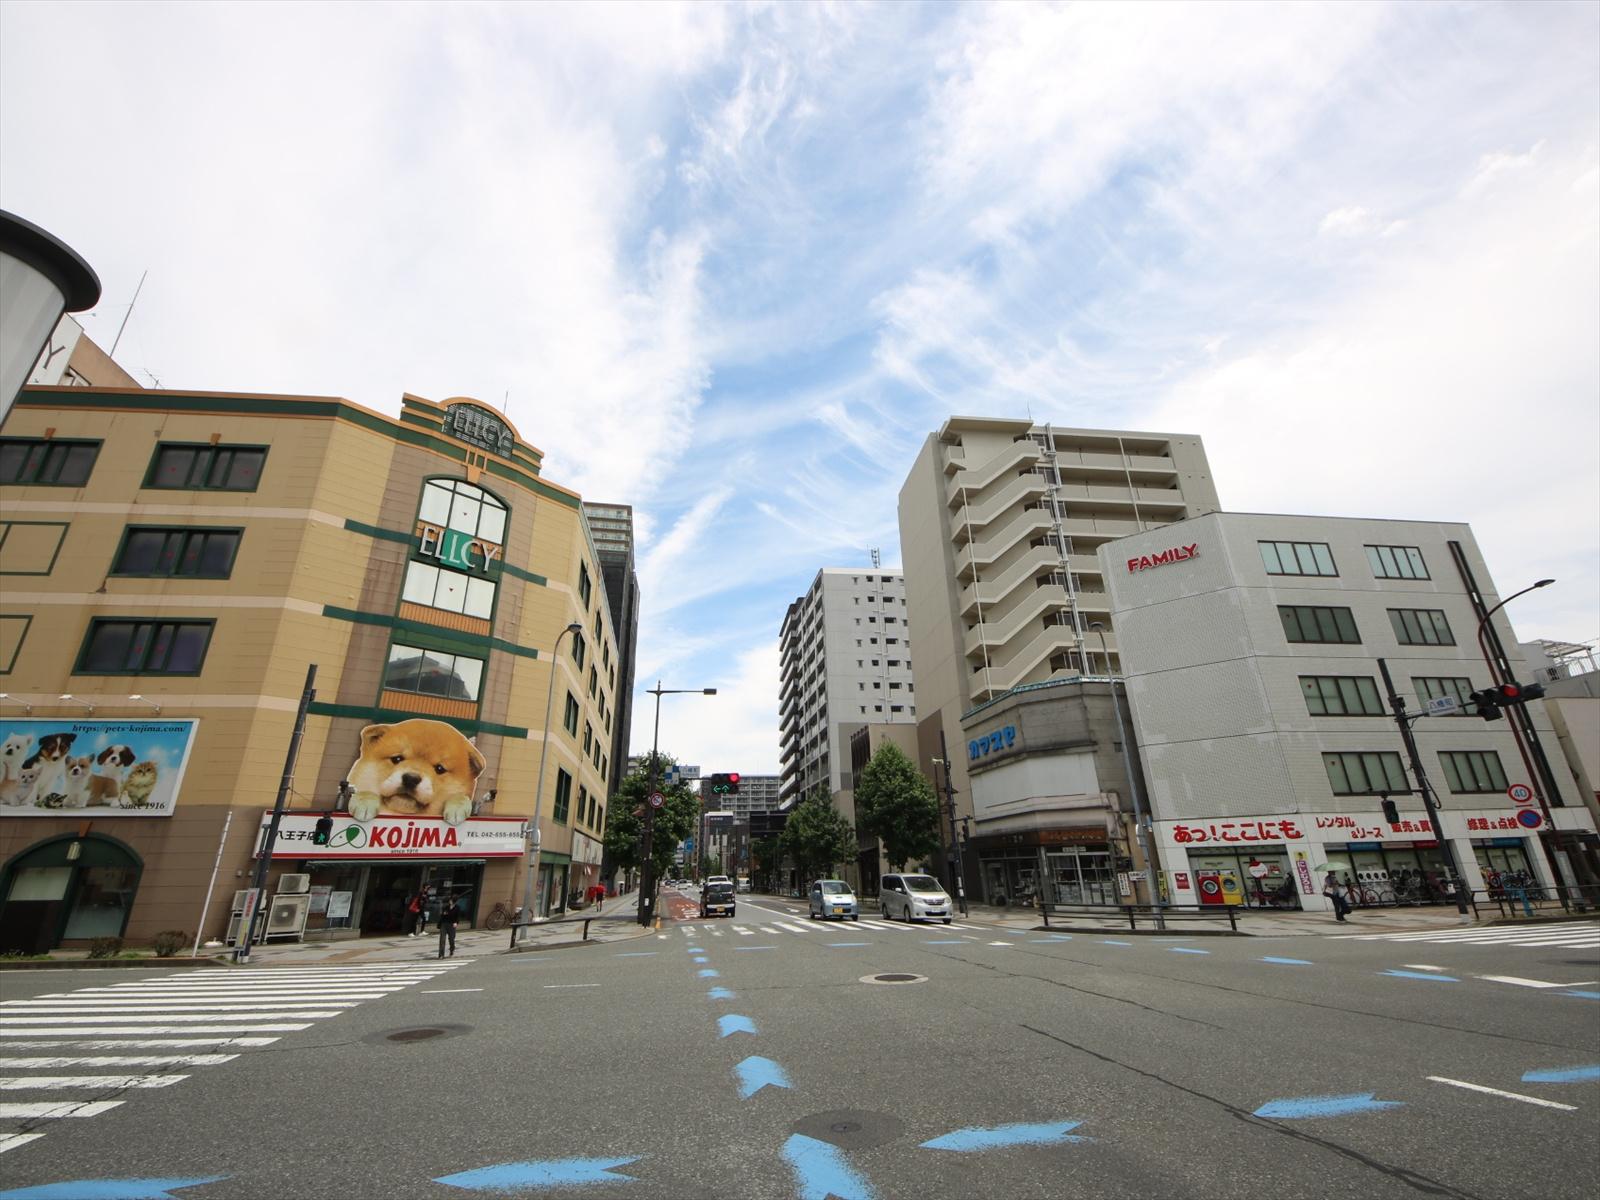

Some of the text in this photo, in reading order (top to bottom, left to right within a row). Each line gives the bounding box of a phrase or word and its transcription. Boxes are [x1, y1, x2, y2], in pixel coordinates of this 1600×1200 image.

[1127, 543, 1197, 572] FAMILY
[72, 724, 188, 734] https://pets-kojima.com/
[1514, 788, 1528, 798] 40
[145, 801, 166, 810] 1916
[1316, 816, 1356, 828] レンタル
[369, 821, 458, 848] KOJIMA
[1173, 820, 1301, 843] あっ!ここにも
